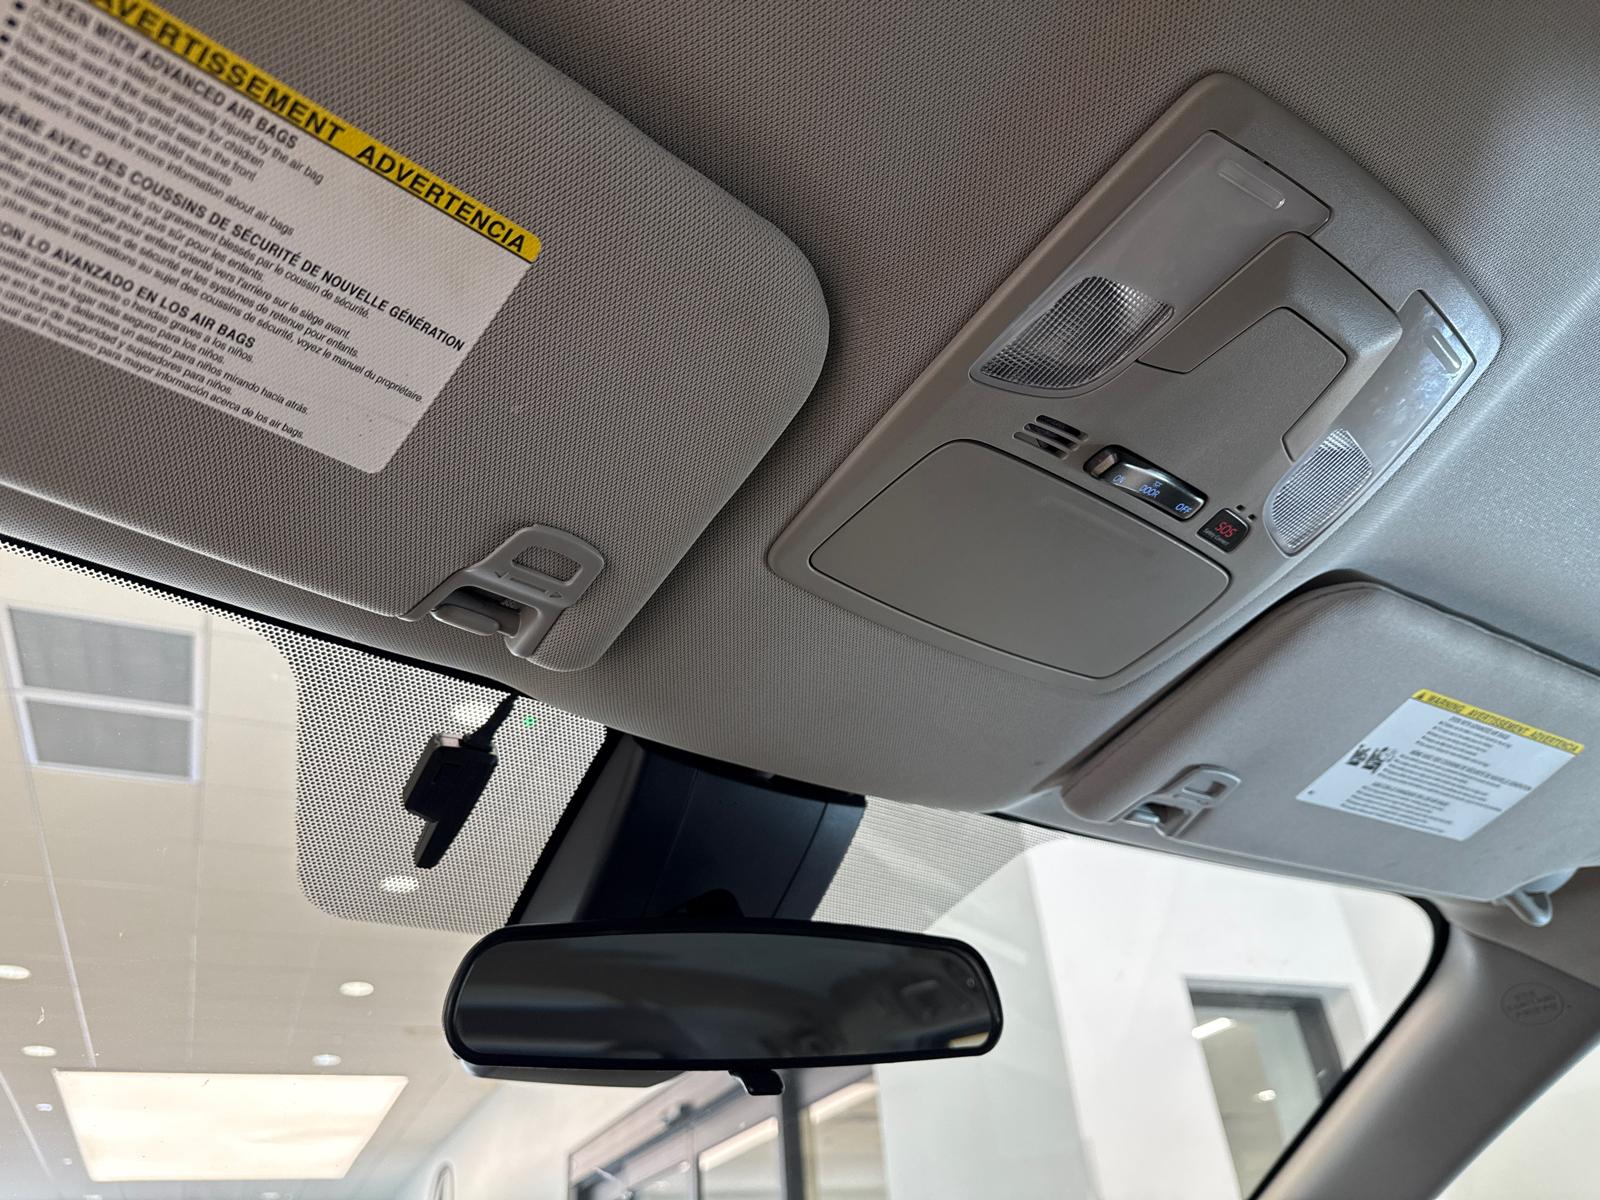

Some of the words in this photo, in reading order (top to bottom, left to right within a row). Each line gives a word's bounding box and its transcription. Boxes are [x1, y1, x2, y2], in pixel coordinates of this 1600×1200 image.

[140, 49, 226, 107] ADVANCED
[227, 100, 255, 123] AIR
[256, 117, 299, 149] BAGS
[213, 152, 230, 167] the
[231, 162, 256, 181] front
[221, 118, 257, 144] injured
[272, 148, 288, 162] the
[289, 159, 302, 171] air
[304, 166, 323, 185] bag
[224, 141, 264, 167] children
[167, 163, 224, 198] information
[225, 195, 255, 215] about
[255, 211, 269, 222] air
[269, 217, 293, 235] bags
[357, 145, 526, 252] ADVERTENCIA
[46, 127, 93, 159] AVEC
[92, 151, 128, 178] DES
[129, 170, 208, 218] COUSSINS
[231, 224, 302, 266] SÉCURITÉ
[321, 271, 389, 311] NOUVELLE
[388, 305, 465, 350] GÉNÉRATION
[143, 218, 167, 232] plus
[168, 229, 184, 241] sûr
[184, 238, 210, 254] pour
[211, 249, 226, 262] les
[227, 259, 263, 281] enfants.
[163, 210, 218, 241] gravement
[218, 236, 255, 260] blessés
[255, 257, 273, 269] par
[285, 272, 319, 292] coussin
[334, 296, 369, 318] sécurité.
[0, 223, 25, 243] ON
[53, 248, 135, 292] AVANZADO
[159, 297, 190, 318] LOS
[190, 311, 216, 329] AIR
[217, 324, 256, 348] BAGS
[139, 248, 181, 271] sécurité
[193, 272, 208, 285] les
[209, 282, 255, 307] systèmes
[269, 311, 304, 330] retenue
[303, 328, 326, 341] pour
[326, 338, 357, 357] enfants.
[144, 234, 178, 254] enfant
[178, 251, 214, 272] orienté
[214, 269, 235, 282] vers
[236, 278, 271, 300] l'arrière
[272, 297, 288, 308] sur
[299, 310, 324, 325] siège
[324, 323, 349, 338] avant.
[65, 319, 117, 344] seguridad
[126, 345, 182, 372] sujetadores
[182, 370, 205, 382] para
[206, 380, 231, 394] niños.
[122, 314, 157, 333] seguro
[157, 330, 180, 343] para
[182, 339, 196, 350] los
[198, 348, 223, 363] niños.
[132, 302, 168, 323] heridas
[169, 321, 202, 338] graves
[212, 338, 227, 349] los
[227, 347, 252, 362] niños.
[153, 271, 179, 286] sujet
[180, 282, 199, 296] des
[200, 293, 242, 316] coussins
[256, 320, 293, 342] sécurité,
[296, 339, 321, 353] voyez
[332, 356, 364, 373] manuel
[375, 377, 422, 402] propriétaire.
[97, 348, 121, 361] para
[123, 358, 153, 374] mayor
[155, 371, 208, 398] información
[209, 395, 240, 411] acerca
[254, 413, 268, 423] los
[268, 420, 280, 428] air
[281, 425, 302, 438] bags.
[136, 335, 172, 354] asiento
[172, 352, 195, 364] para
[196, 362, 221, 376] niños
[223, 374, 259, 392] mirando
[260, 388, 284, 403] hacia
[285, 401, 307, 414] atrás.
[1112, 474, 1126, 484] ON
[1139, 484, 1160, 498] DOOR
[1175, 503, 1192, 514] OFF
[1215, 521, 1237, 537] SOS
[1427, 693, 1465, 713] WARNING
[1467, 709, 1530, 734] AVERTISSEMENT
[1530, 728, 1580, 752] ADVERTENCIA
